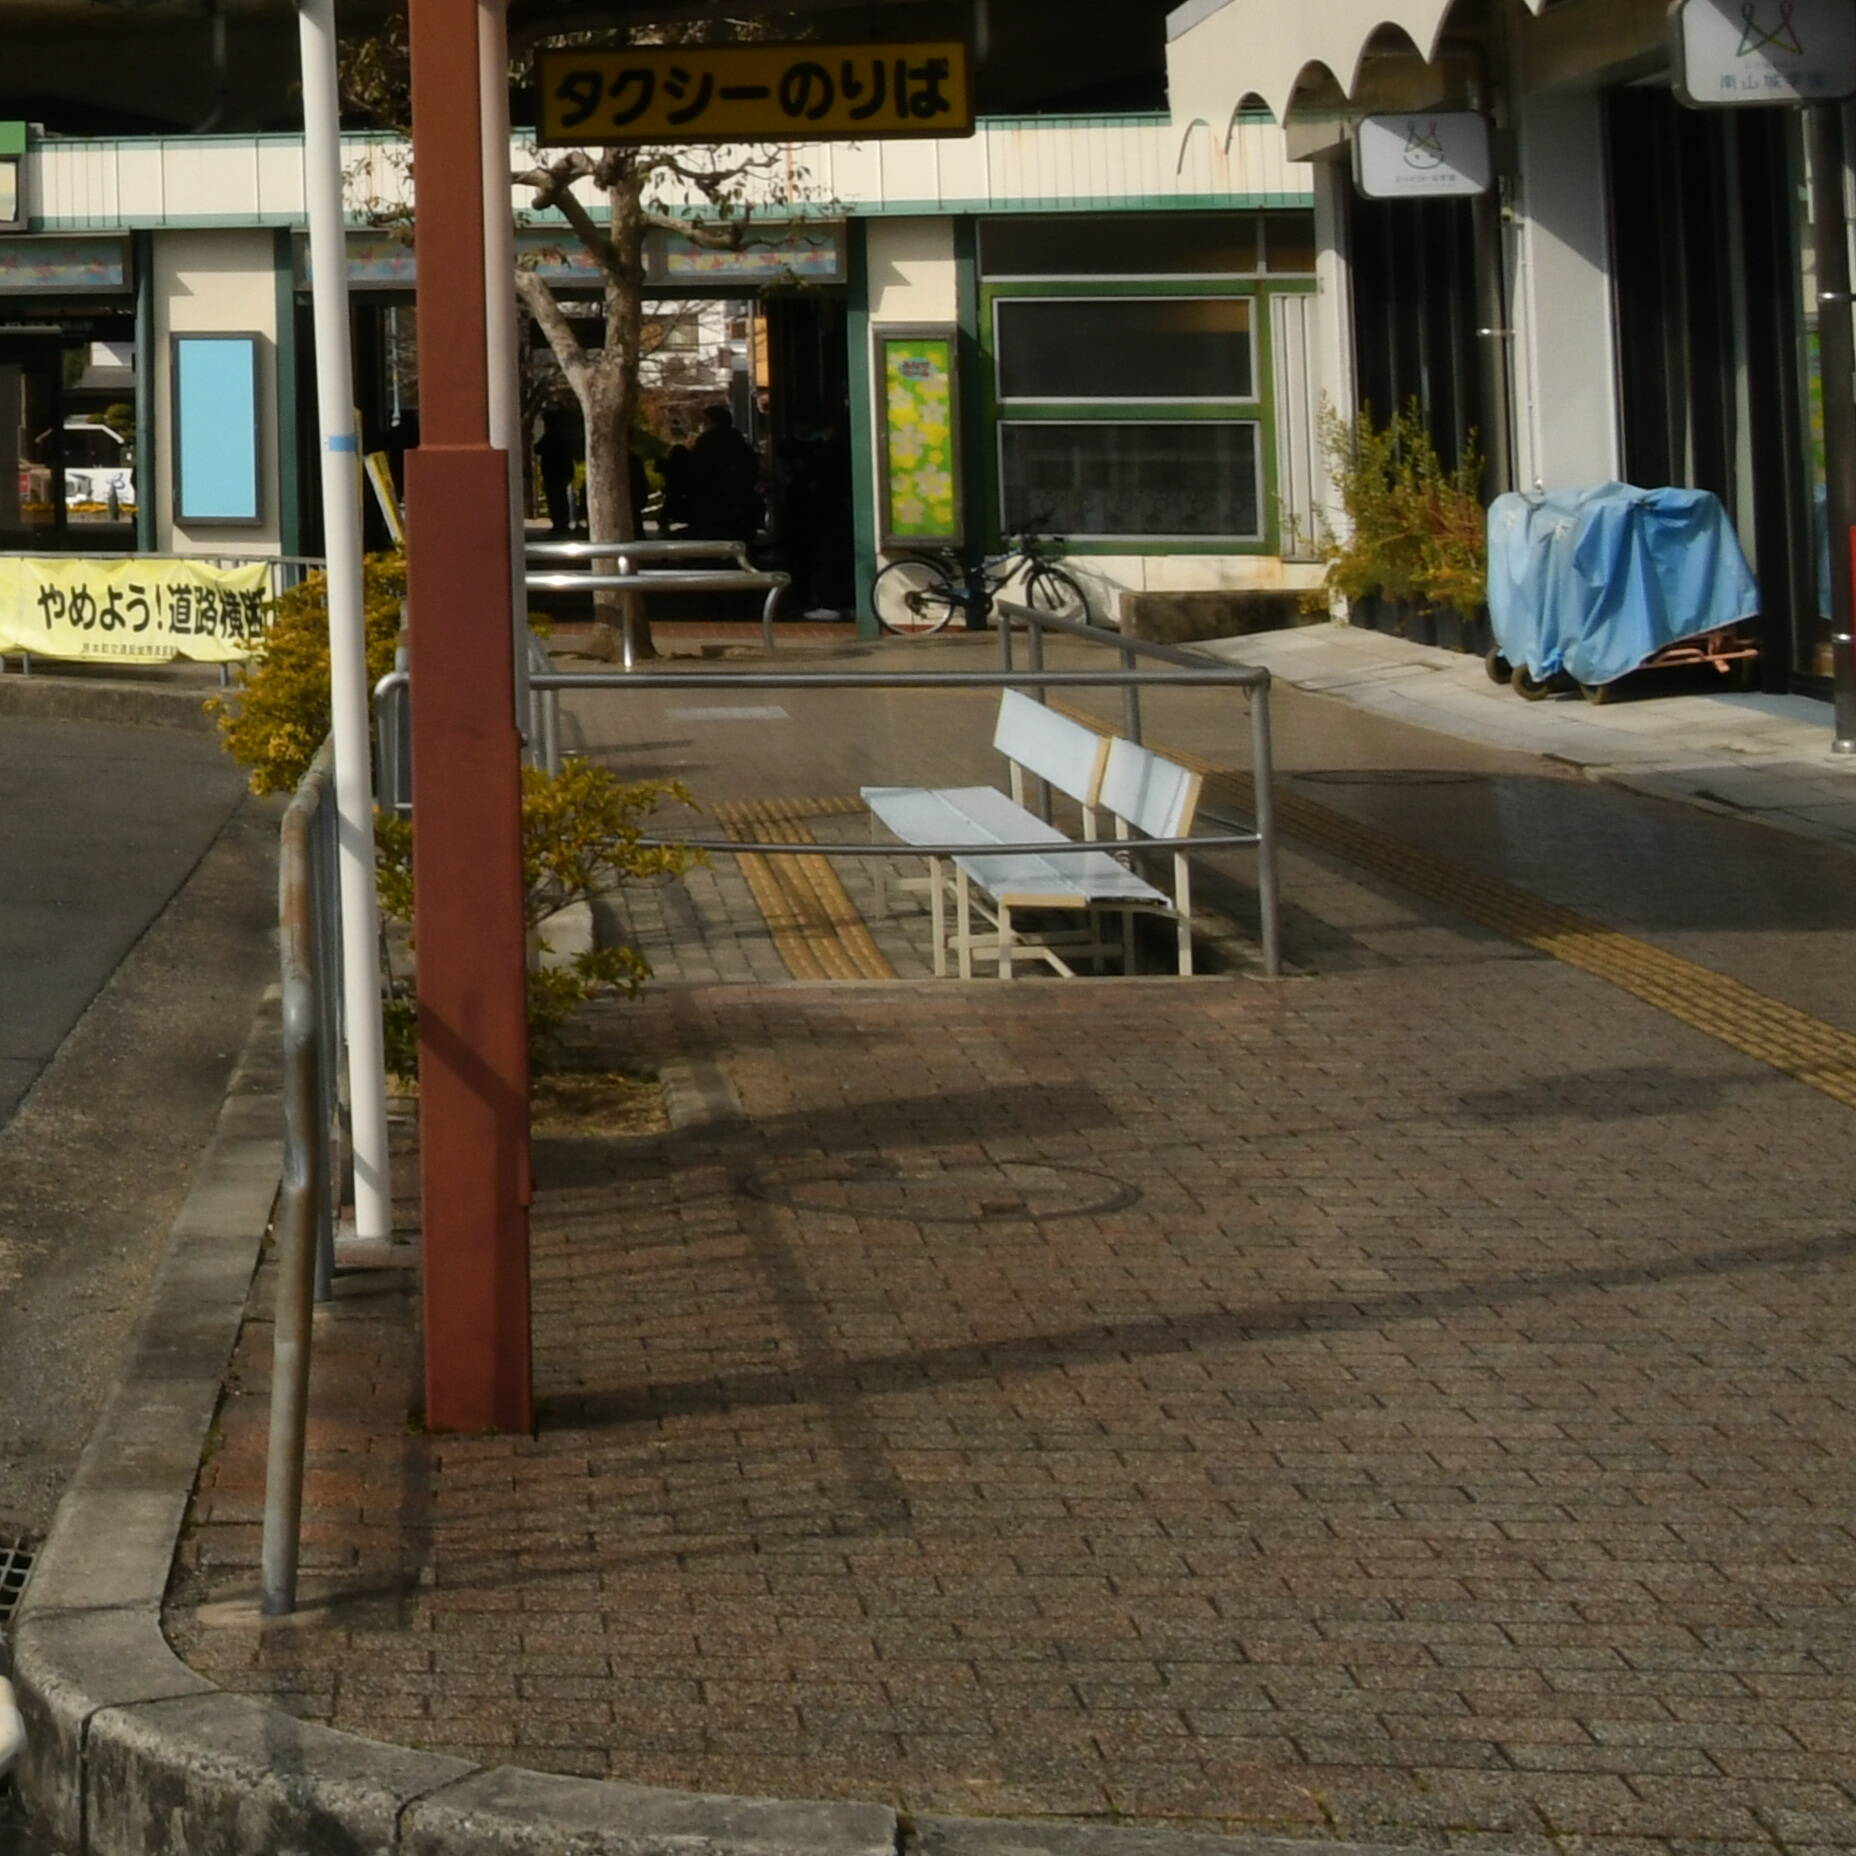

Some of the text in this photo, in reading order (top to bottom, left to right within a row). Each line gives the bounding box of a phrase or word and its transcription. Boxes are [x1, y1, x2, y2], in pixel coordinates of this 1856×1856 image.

[556, 56, 951, 128] タクシーのりば
